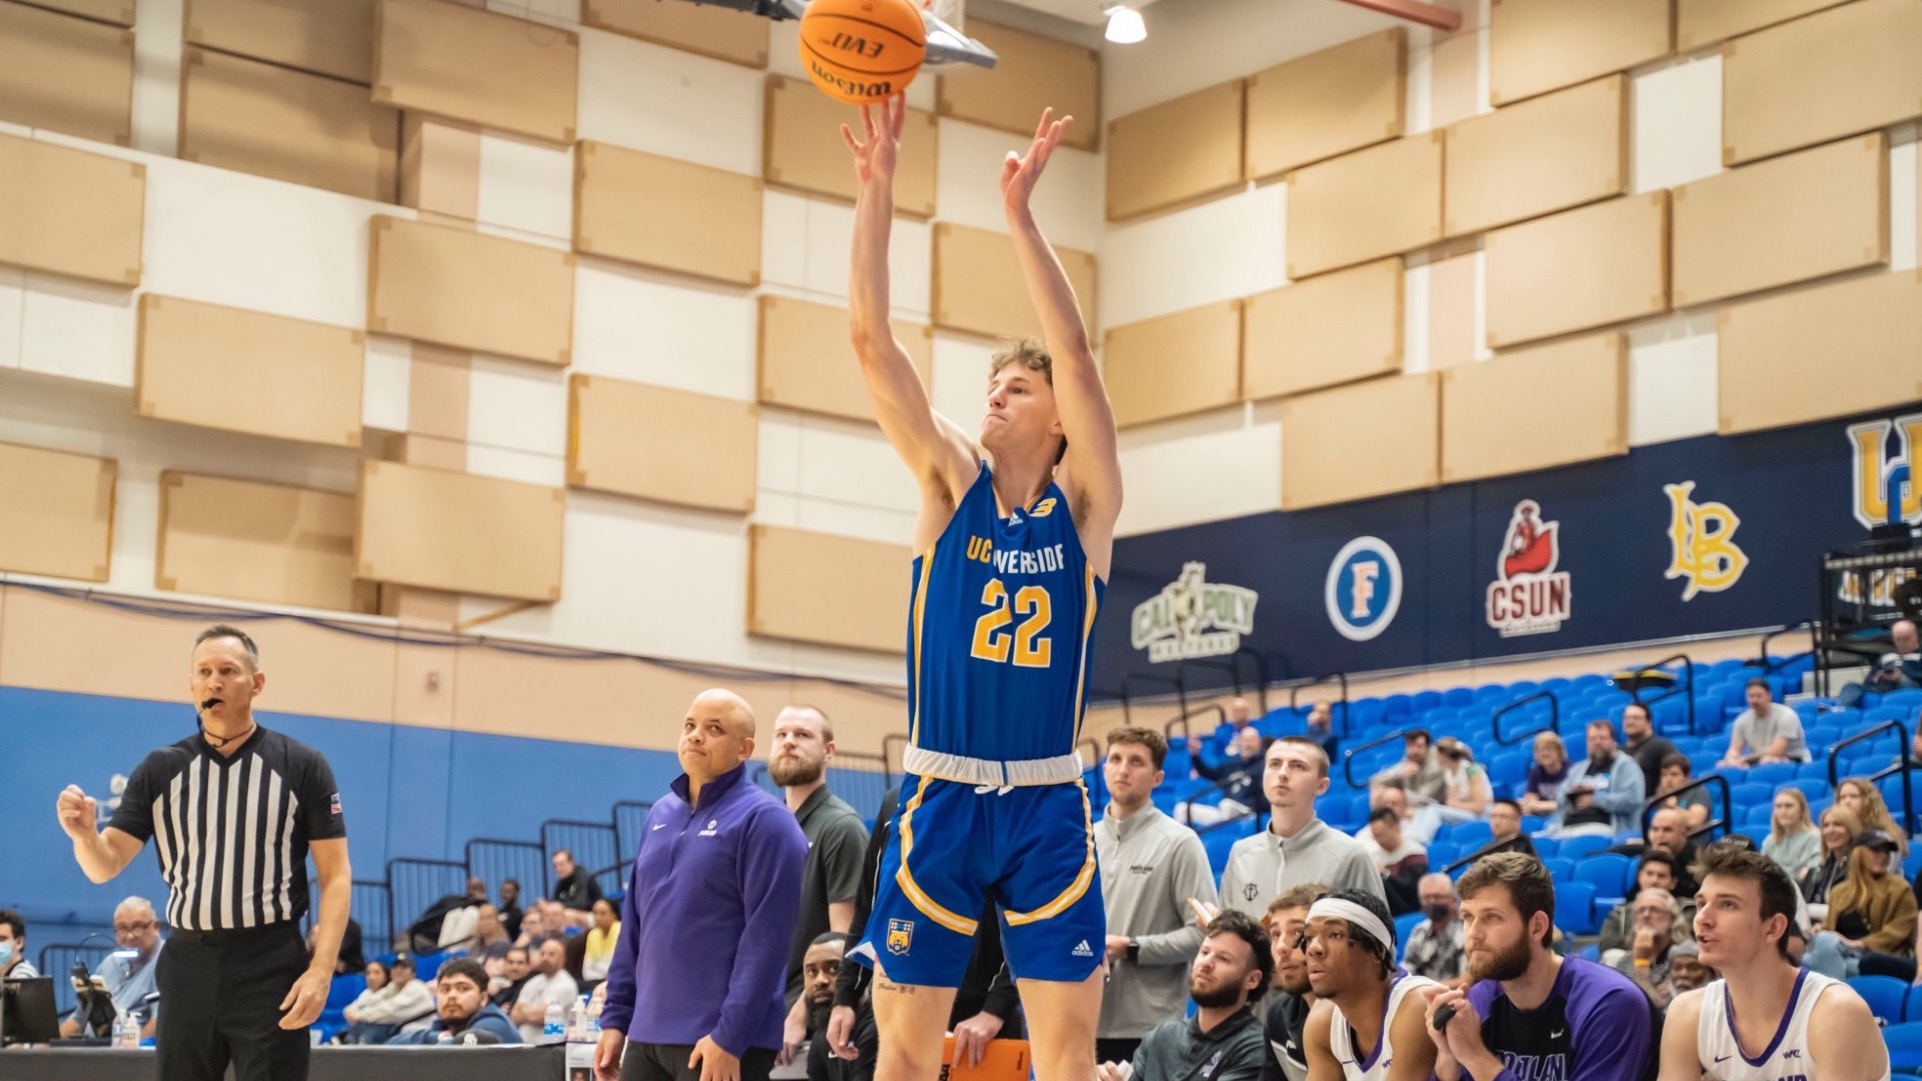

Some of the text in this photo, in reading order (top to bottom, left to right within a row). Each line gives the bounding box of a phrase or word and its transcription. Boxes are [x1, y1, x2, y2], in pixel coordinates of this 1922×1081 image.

[966, 535, 993, 564] UC
[1350, 560, 1379, 619] F
[1491, 578, 1566, 622] CSUN
[970, 577, 1053, 668] 22
